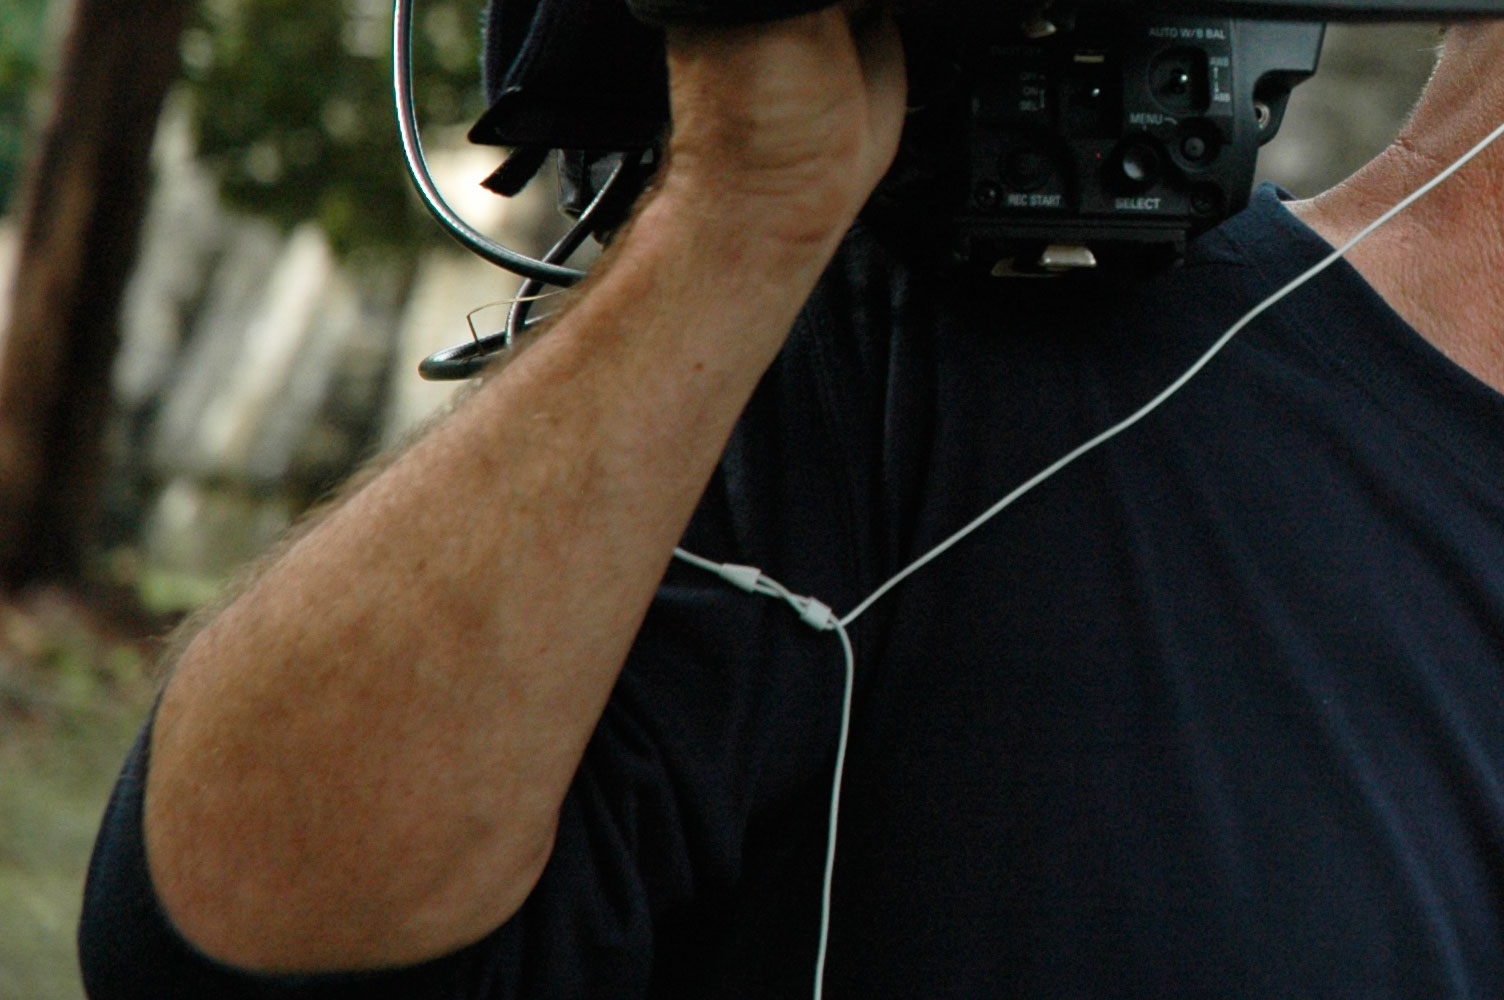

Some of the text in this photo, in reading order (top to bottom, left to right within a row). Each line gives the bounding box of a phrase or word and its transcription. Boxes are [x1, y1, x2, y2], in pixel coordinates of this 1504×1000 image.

[1149, 27, 1178, 39] AUTO
[1205, 28, 1227, 40] BAL
[1129, 112, 1163, 126] MENU
[1007, 194, 1062, 207] REC START
[1115, 197, 1161, 210] SELECT
